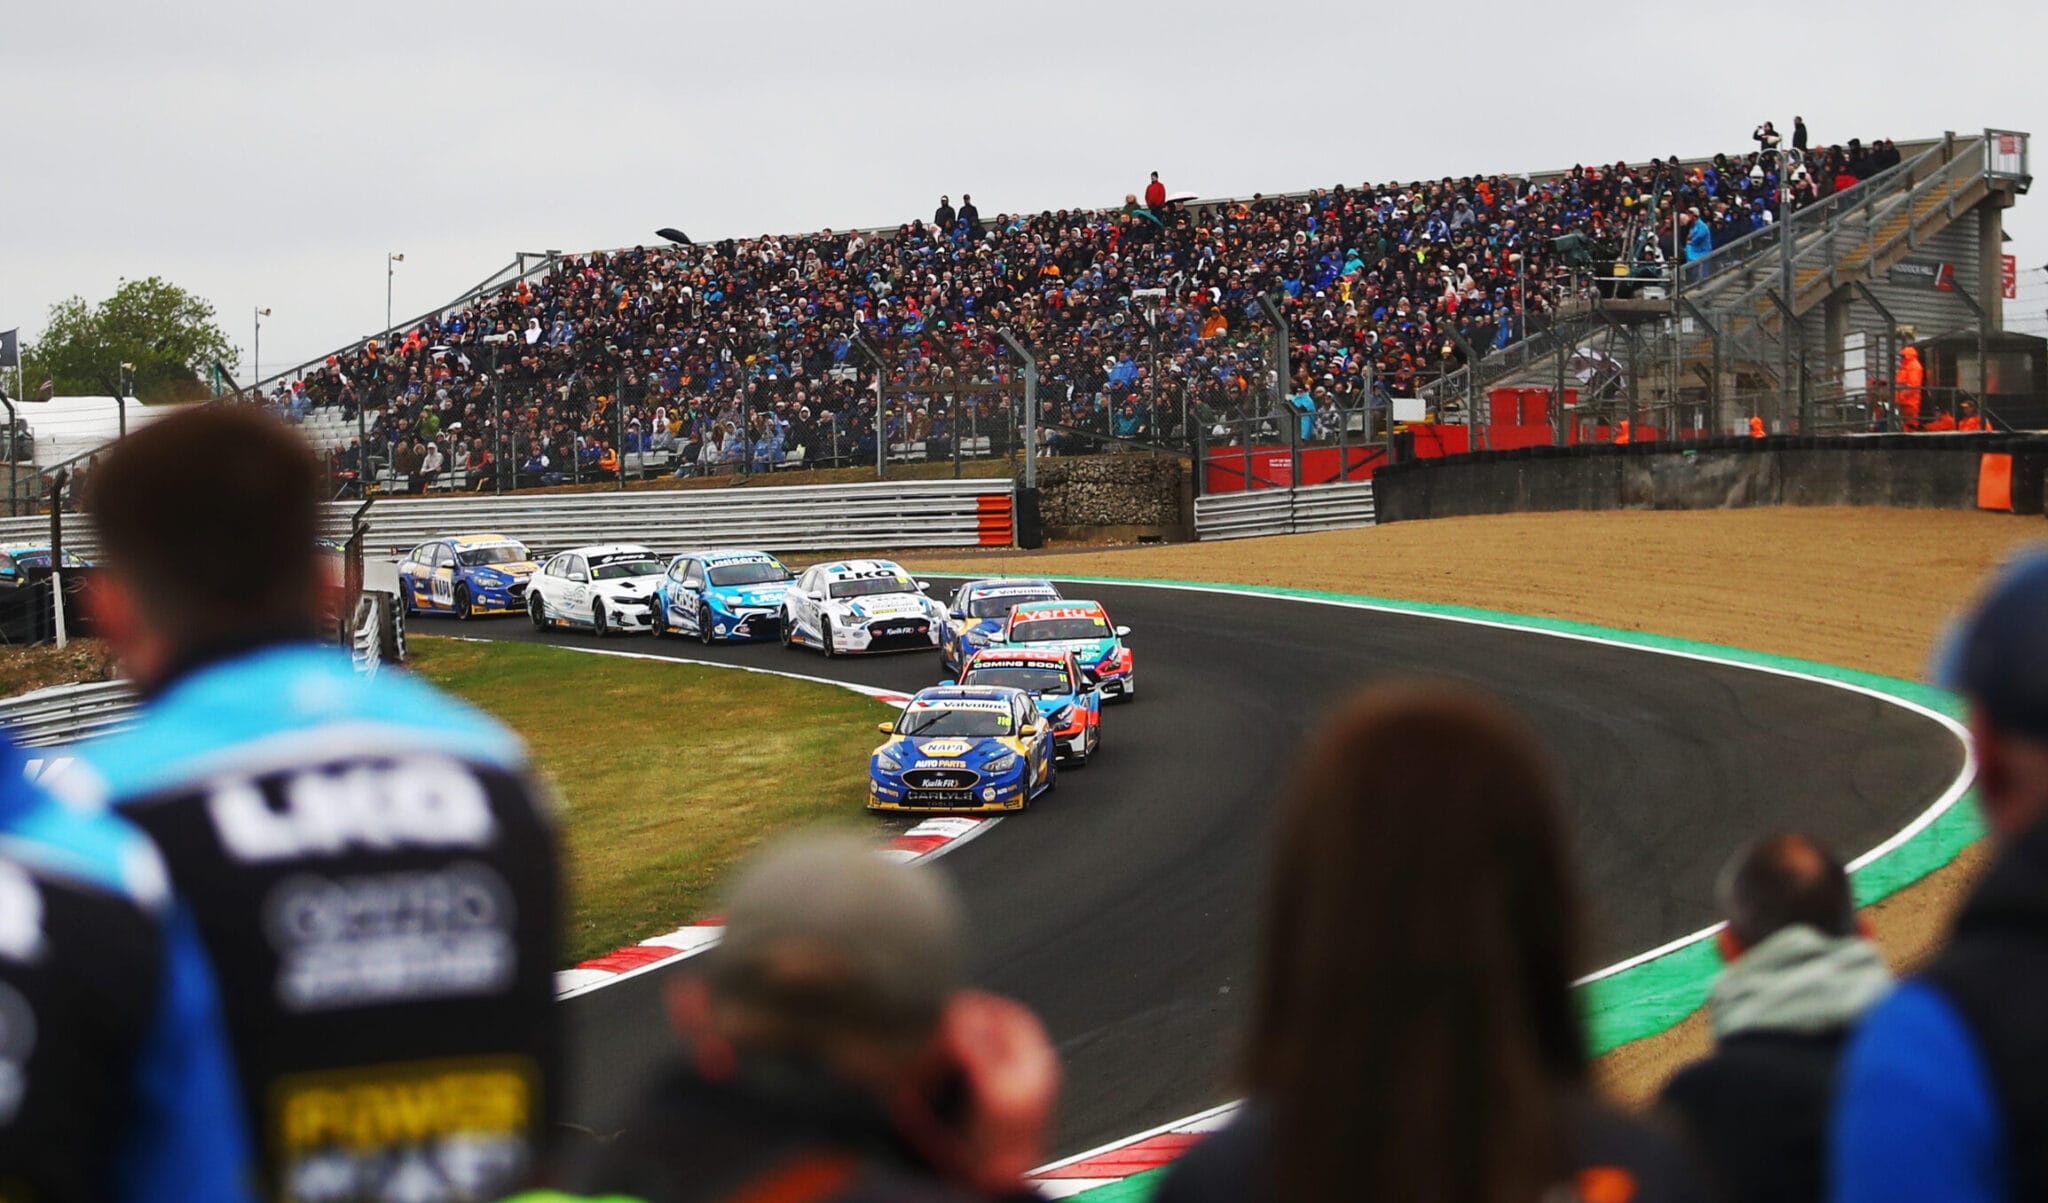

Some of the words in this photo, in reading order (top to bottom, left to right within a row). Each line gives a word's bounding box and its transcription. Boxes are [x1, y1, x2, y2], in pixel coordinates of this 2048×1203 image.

[973, 660, 1024, 669] COMING
[1027, 660, 1064, 670] SOON
[1058, 673, 1068, 683] 11
[943, 701, 1007, 709] Valvoline
[927, 743, 964, 752] NAPA
[914, 760, 938, 768] AUTO
[938, 760, 967, 768] PARTS
[921, 779, 943, 788] Kwik
[907, 791, 973, 800] CARLYLE
